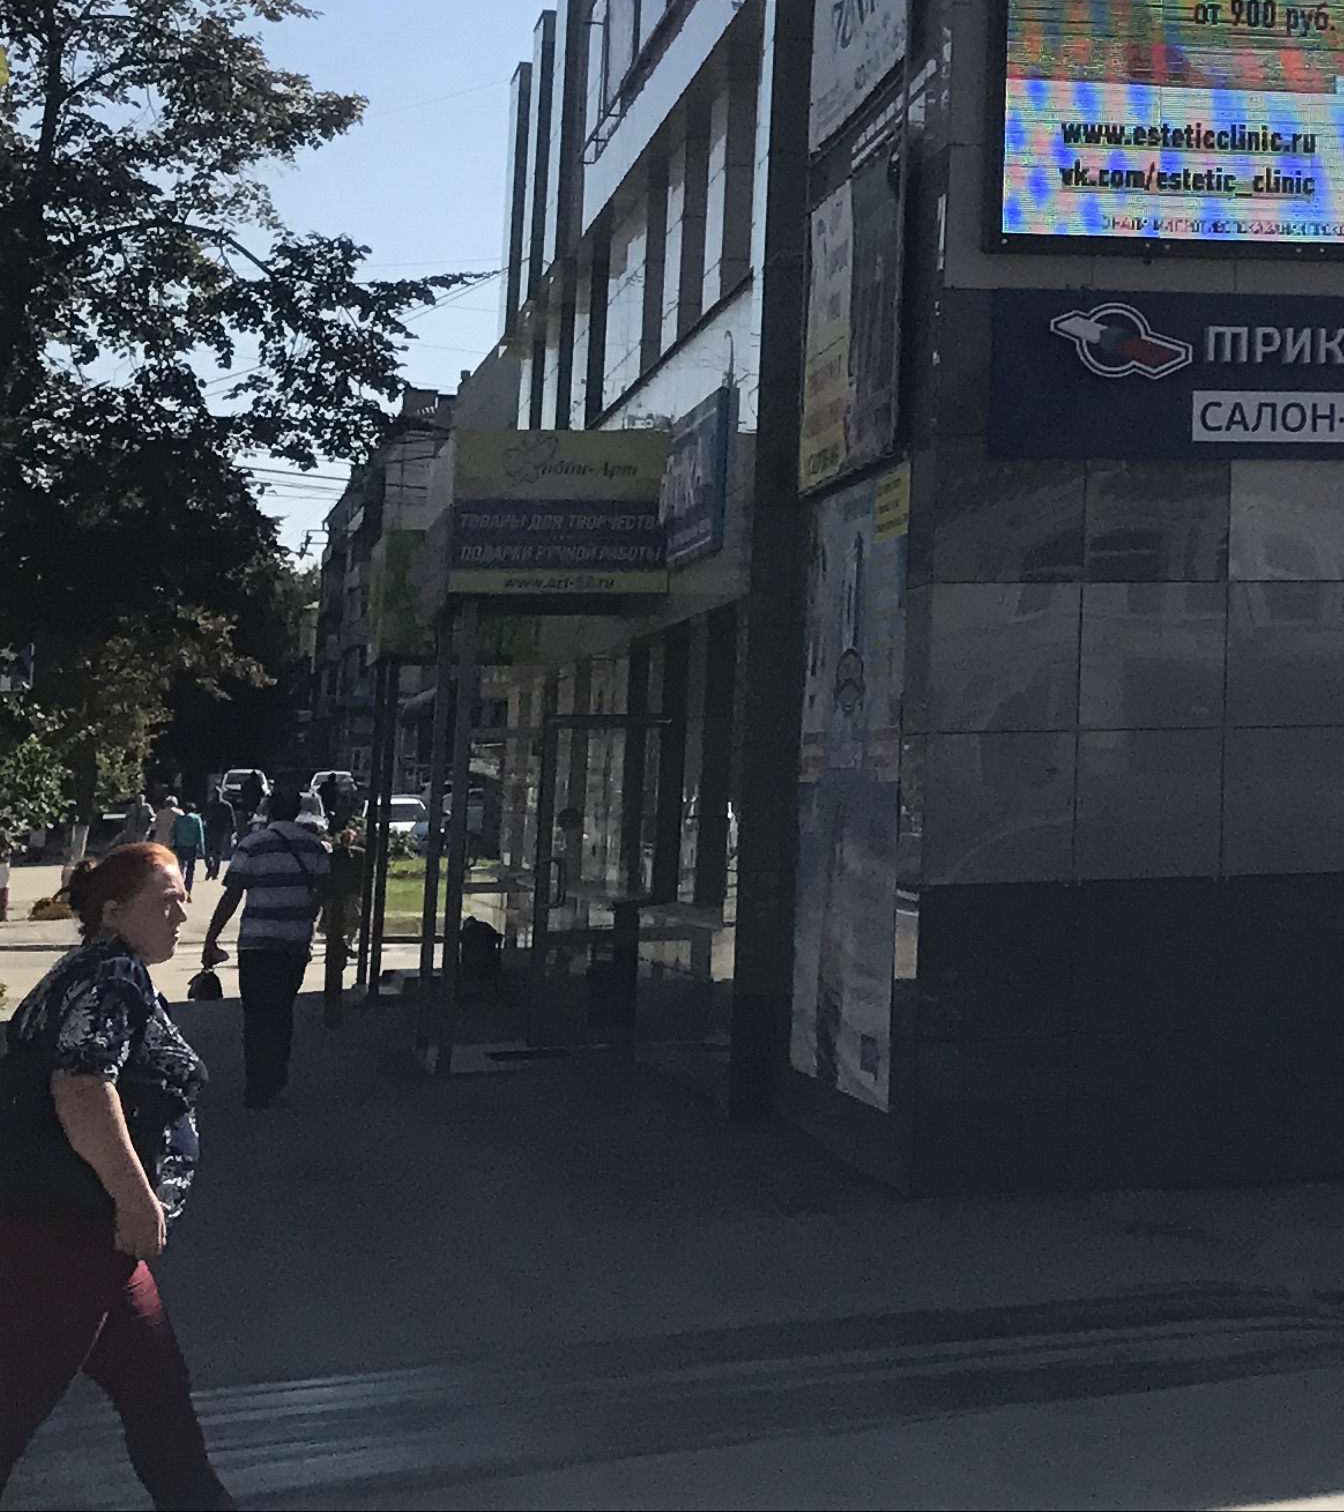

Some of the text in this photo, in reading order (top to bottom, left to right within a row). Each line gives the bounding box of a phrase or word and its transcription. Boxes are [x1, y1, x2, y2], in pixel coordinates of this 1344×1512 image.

[1194, 1, 1221, 25] от
[1285, 2, 1337, 36] руб.
[1061, 121, 1316, 154] www.esteticclinic.ru
[1059, 159, 1316, 198] vk.com/estetic_clinic
[527, 514, 564, 531] ДЛЯ
